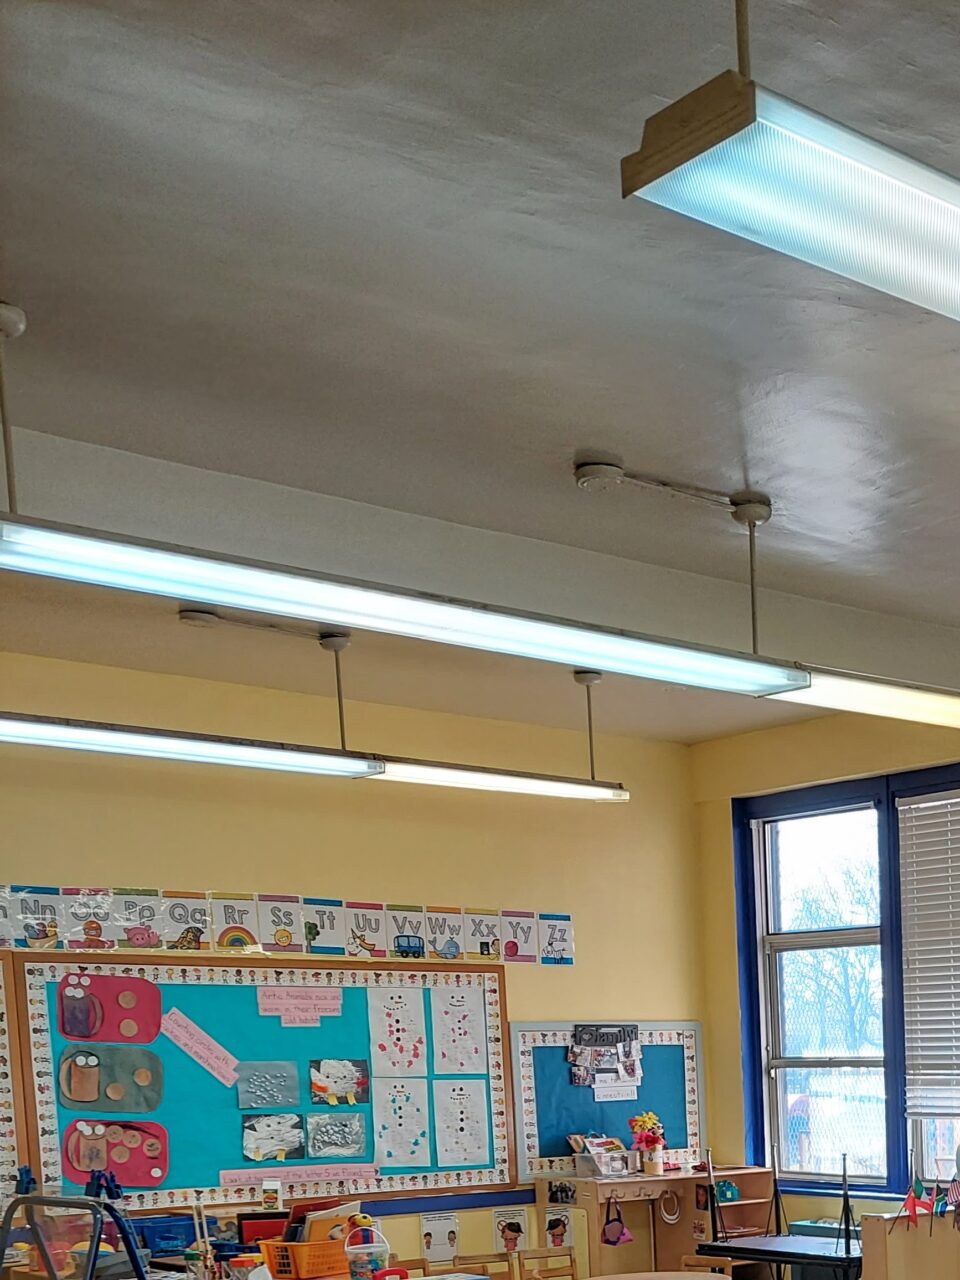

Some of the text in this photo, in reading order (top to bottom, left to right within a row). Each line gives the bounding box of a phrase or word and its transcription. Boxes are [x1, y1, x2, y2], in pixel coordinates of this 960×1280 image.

[124, 900, 156, 926] Pp
[169, 902, 207, 928] Qq
[223, 905, 249, 925] Rr
[270, 906, 294, 927] Ss
[315, 910, 336, 930] Tt
[354, 913, 380, 933] Uu
[392, 916, 422, 935] Vv
[427, 917, 461, 936] Ww
[471, 919, 497, 937] Xx
[508, 921, 532, 944] Yy
[547, 924, 567, 943] Zz
